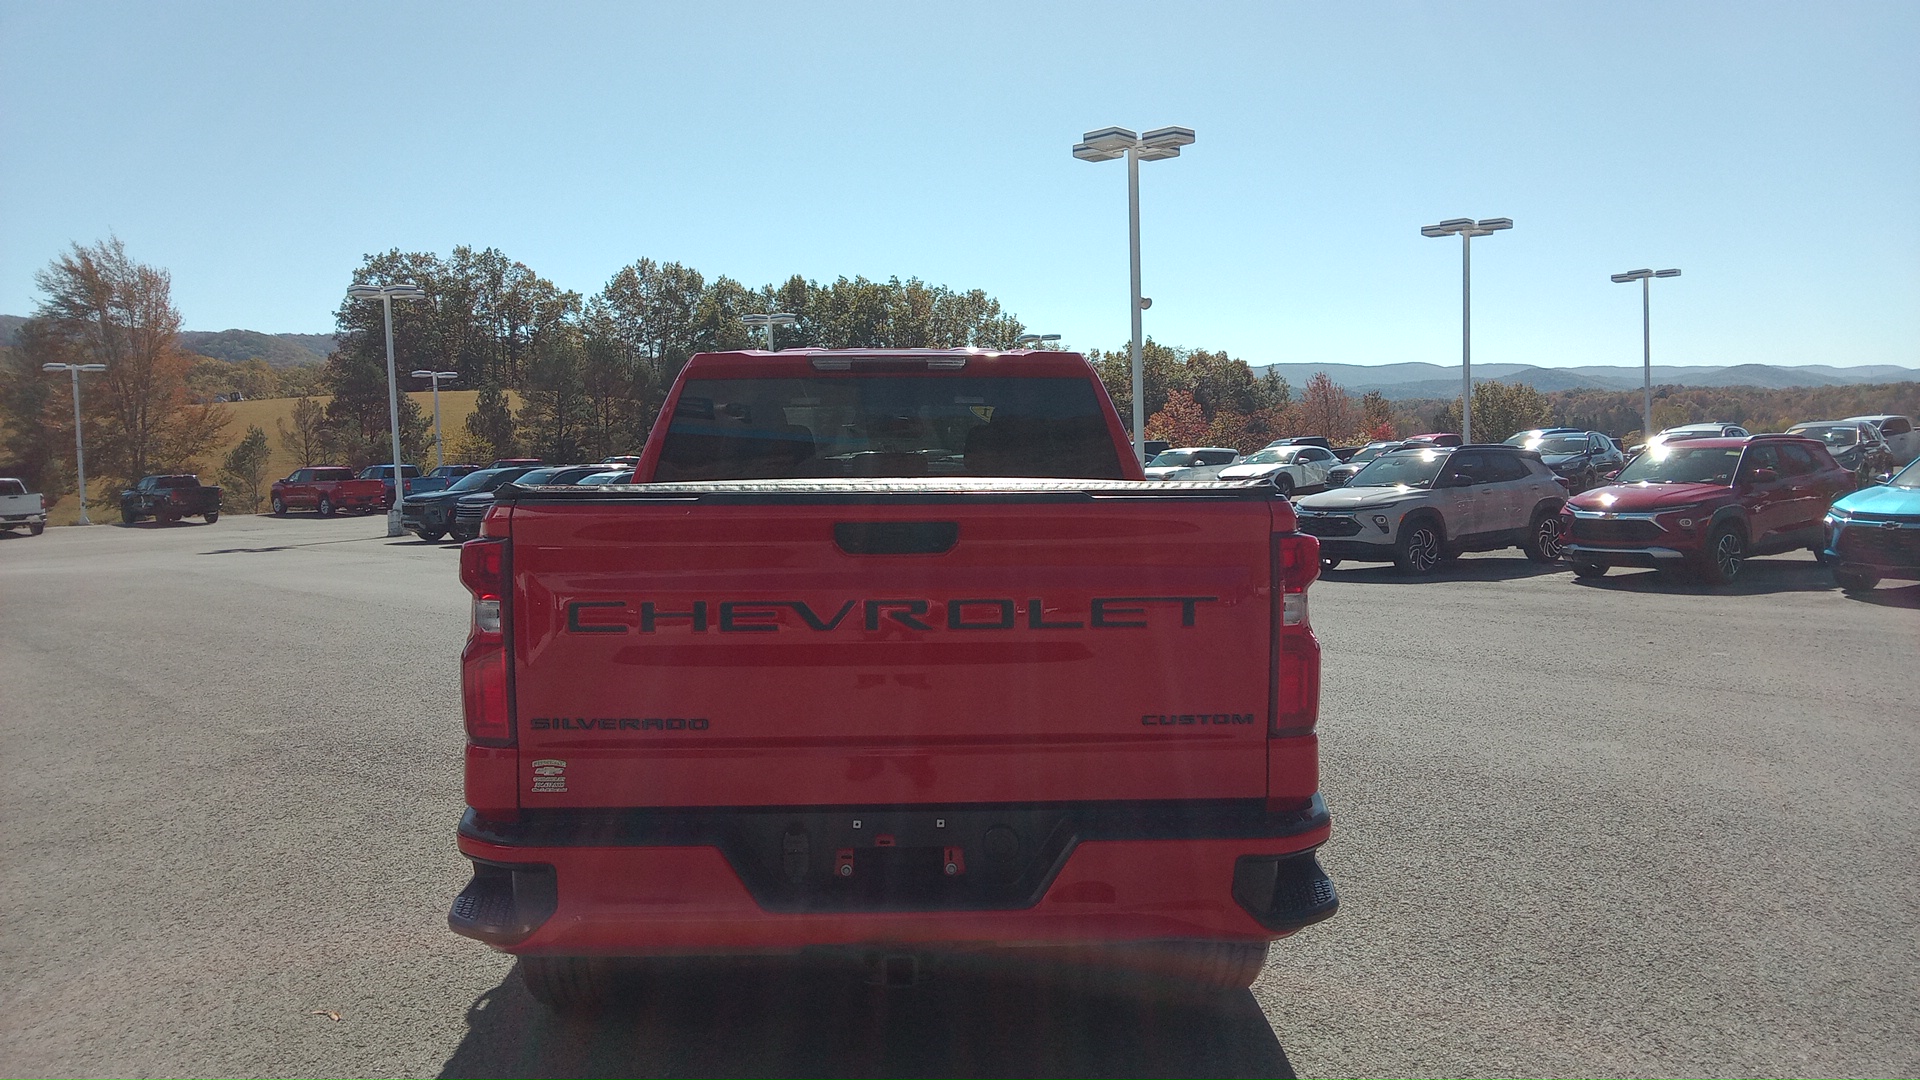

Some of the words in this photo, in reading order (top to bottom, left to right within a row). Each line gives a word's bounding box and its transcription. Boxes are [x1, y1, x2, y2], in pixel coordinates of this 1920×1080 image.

[569, 597, 1218, 632] CHEVROLET
[530, 718, 709, 730] SILVERADO
[1142, 713, 1254, 726] CUSTOM
